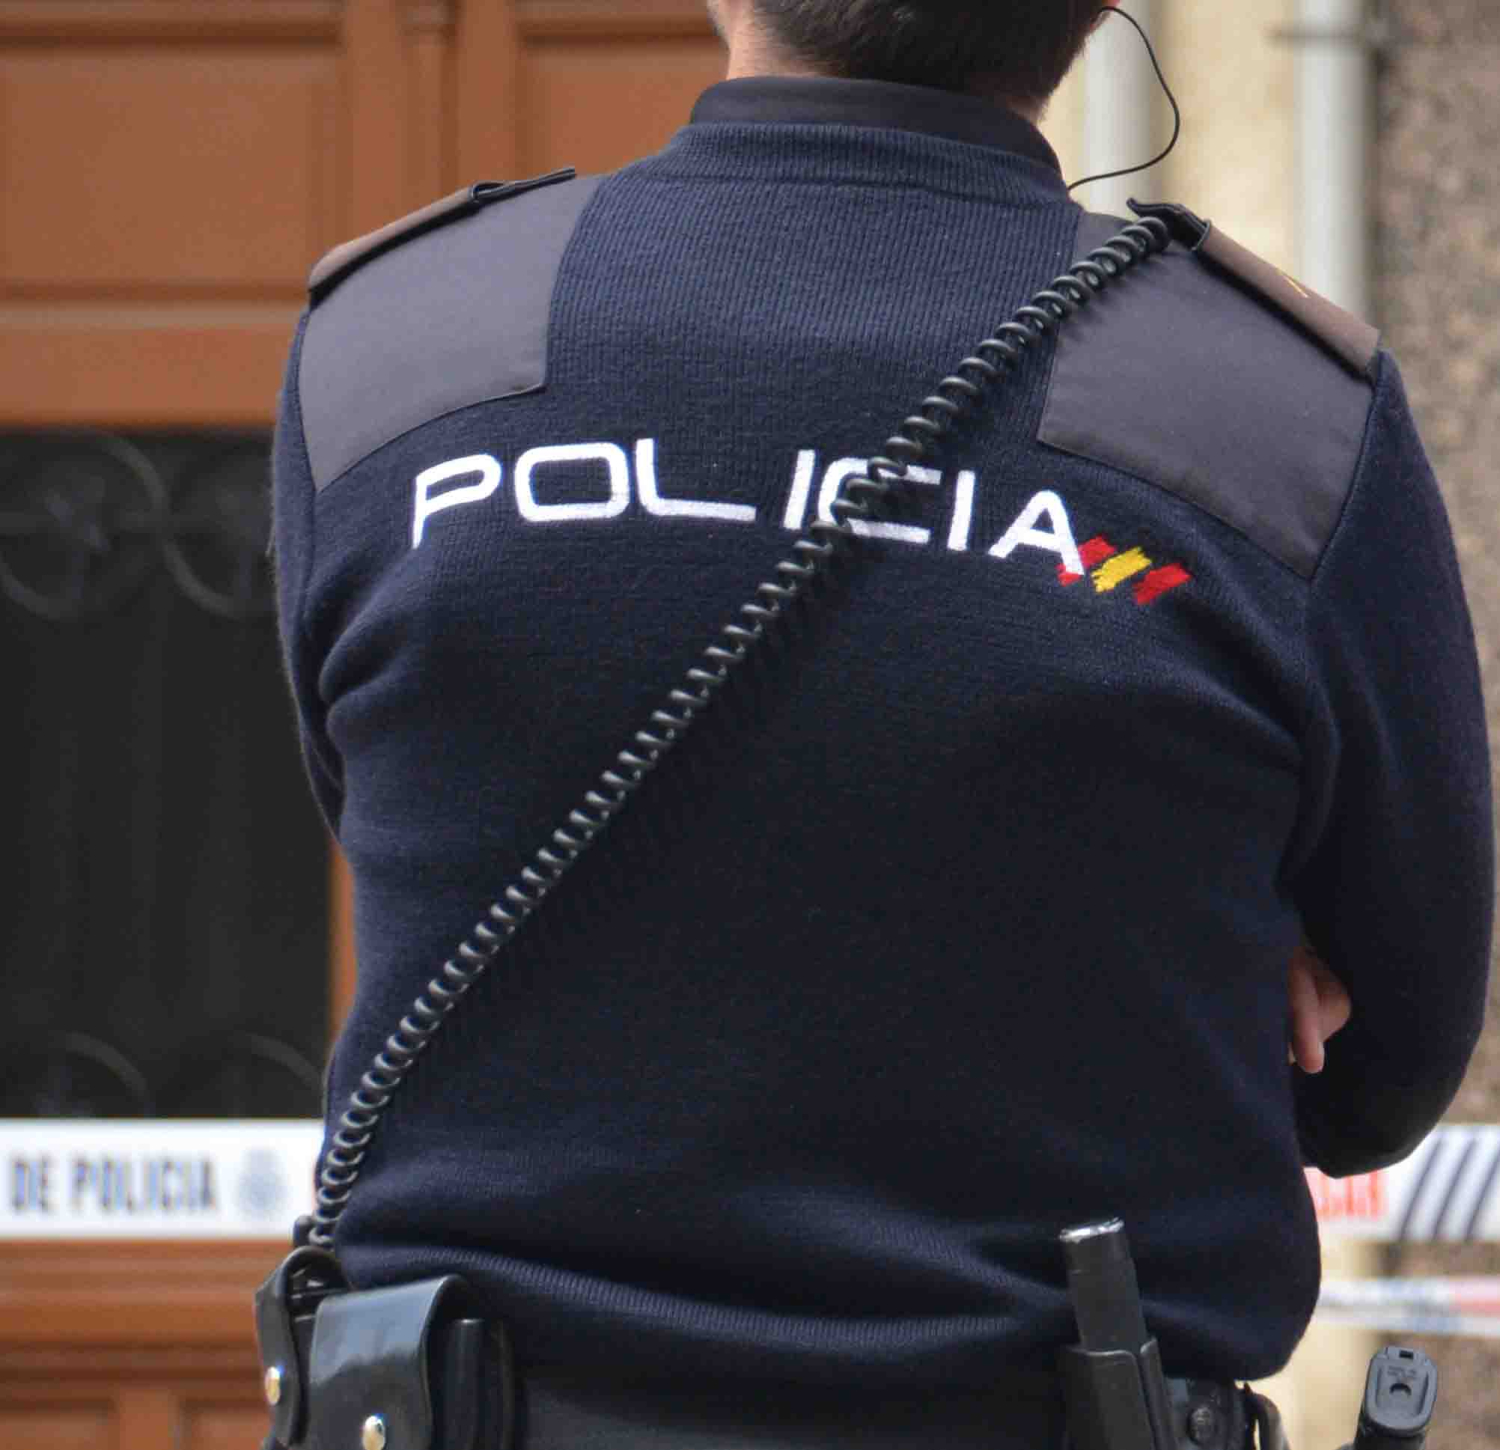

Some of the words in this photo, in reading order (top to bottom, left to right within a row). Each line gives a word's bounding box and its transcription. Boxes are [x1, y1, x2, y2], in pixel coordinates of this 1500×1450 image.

[411, 437, 1086, 577] POLICIA
[10, 1157, 52, 1211] DE
[71, 1157, 218, 1211] POLICIA
